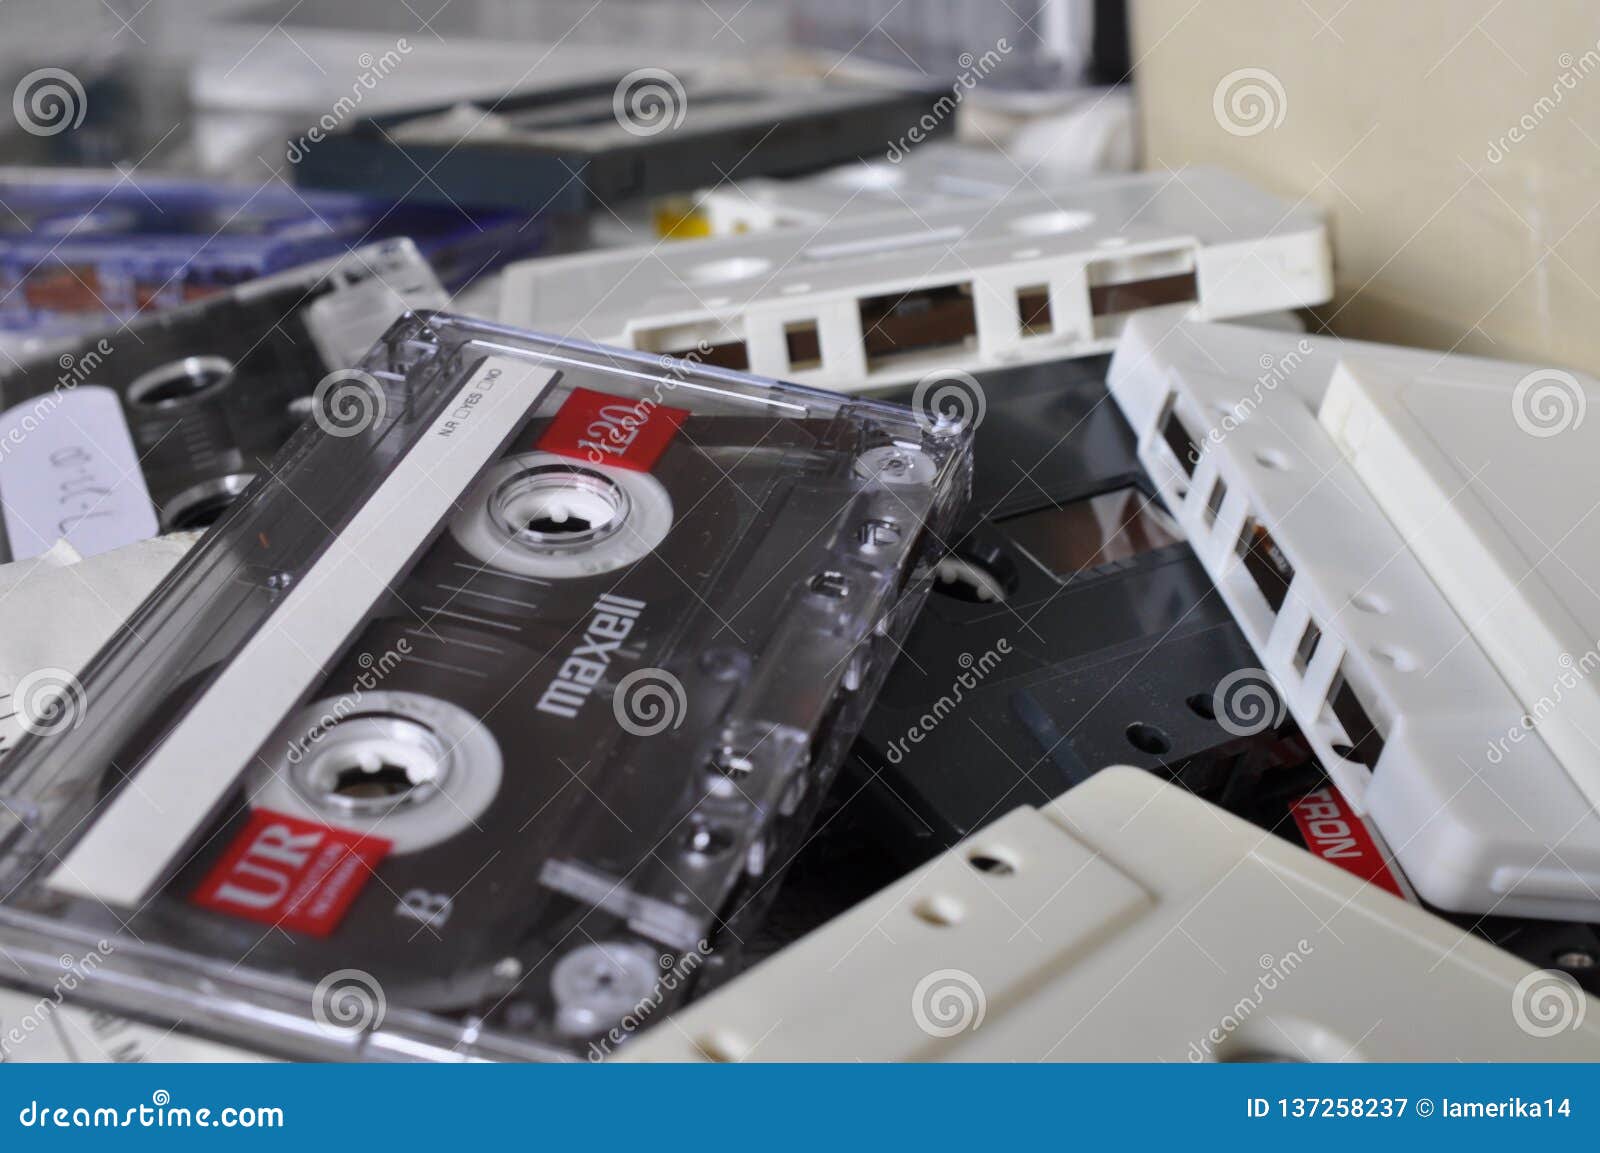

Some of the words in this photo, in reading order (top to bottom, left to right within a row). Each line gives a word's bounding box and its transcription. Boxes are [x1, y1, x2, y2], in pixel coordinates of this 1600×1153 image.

[484, 368, 502, 382] NO
[578, 404, 649, 456] 120
[535, 593, 647, 718] maxell
[214, 823, 326, 910] UR
[395, 888, 455, 929] B
